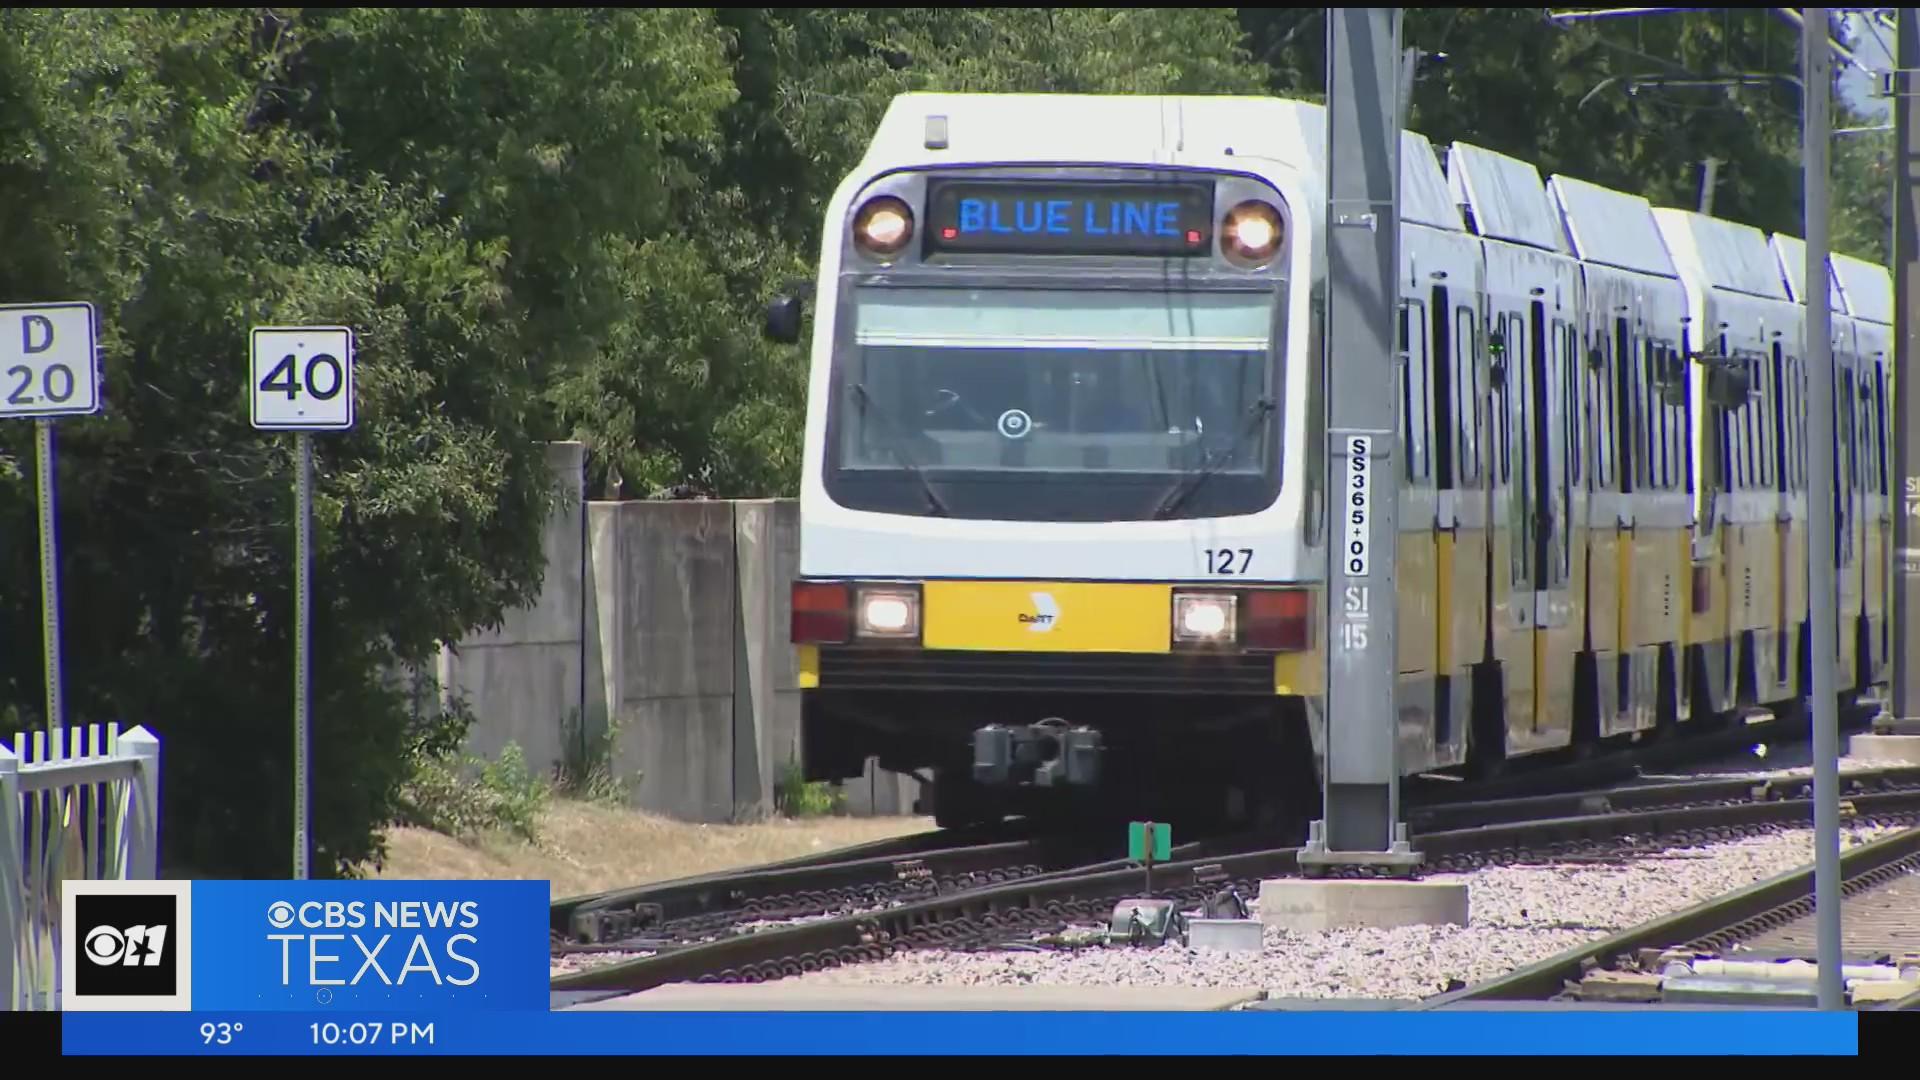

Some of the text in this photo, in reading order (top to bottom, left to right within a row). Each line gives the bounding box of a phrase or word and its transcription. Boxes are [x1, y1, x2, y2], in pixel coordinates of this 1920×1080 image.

[959, 198, 1181, 238] BLUE LINE
[22, 314, 54, 354] D
[259, 353, 343, 401] 40
[1204, 548, 1254, 575] 127
[1344, 623, 1368, 649] 15
